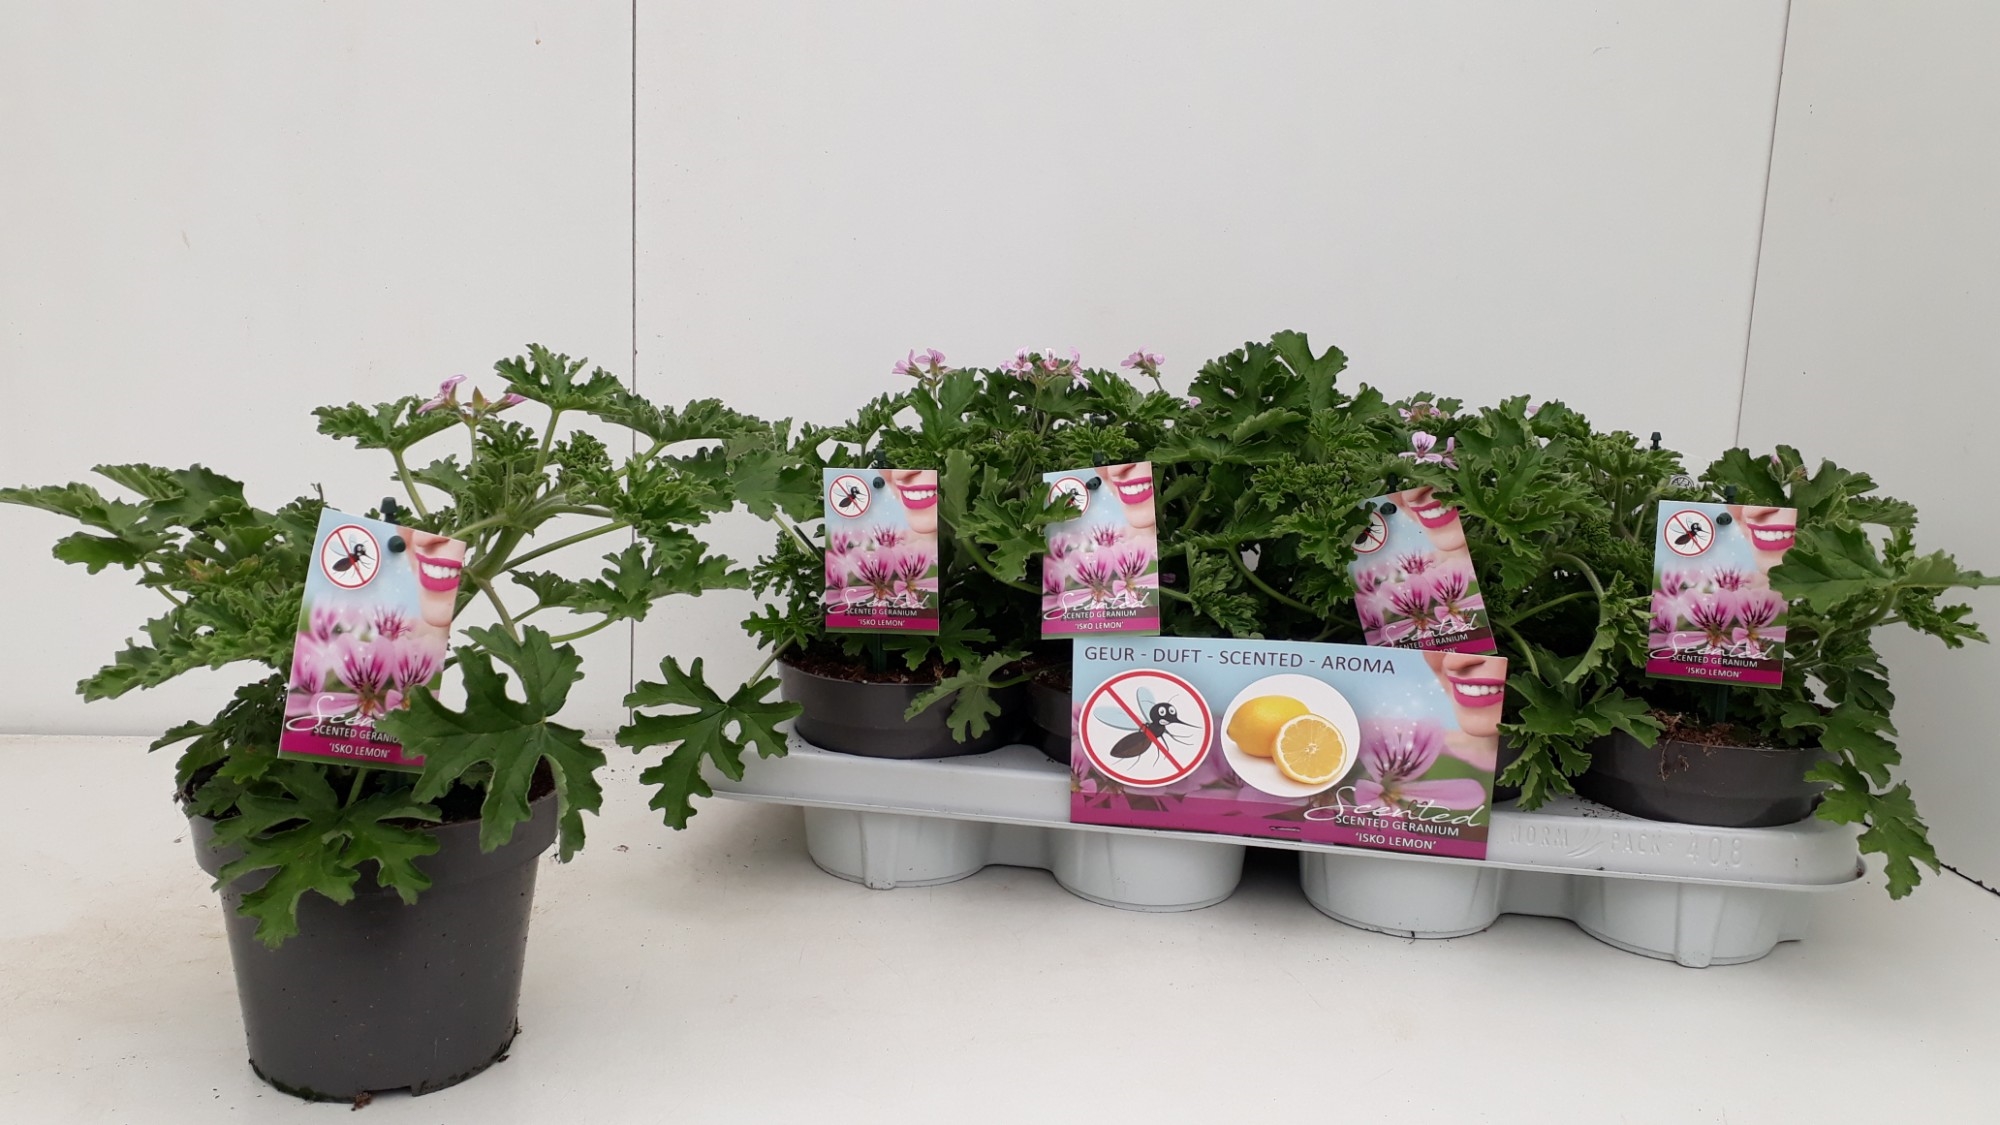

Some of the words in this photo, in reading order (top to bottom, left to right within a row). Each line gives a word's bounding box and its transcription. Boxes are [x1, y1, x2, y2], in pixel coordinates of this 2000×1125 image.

[827, 588, 930, 614] Scented
[879, 609, 918, 617] GERANIUM
[1043, 591, 1150, 620] Scented
[1063, 611, 1095, 619] SCENTED
[1096, 610, 1137, 619] GERANIUM
[1426, 633, 1469, 647] GERANIUM
[1650, 633, 1775, 661] Scented
[1084, 645, 1135, 662] GEUR
[1152, 648, 1201, 665] DUFT
[1219, 650, 1304, 668] SCENTED
[1321, 656, 1396, 675] AROMA
[1672, 654, 1709, 664] SCENTED
[1711, 658, 1758, 668] GERANIUM
[286, 695, 385, 732] Scen
[314, 725, 356, 738] SCENTED
[360, 730, 402, 744] GERANIU
[1303, 785, 1485, 827] Scented
[1335, 814, 1389, 830] SCENTED
[1392, 820, 1460, 837] GERANIUM
[1509, 825, 1569, 849] NORM
